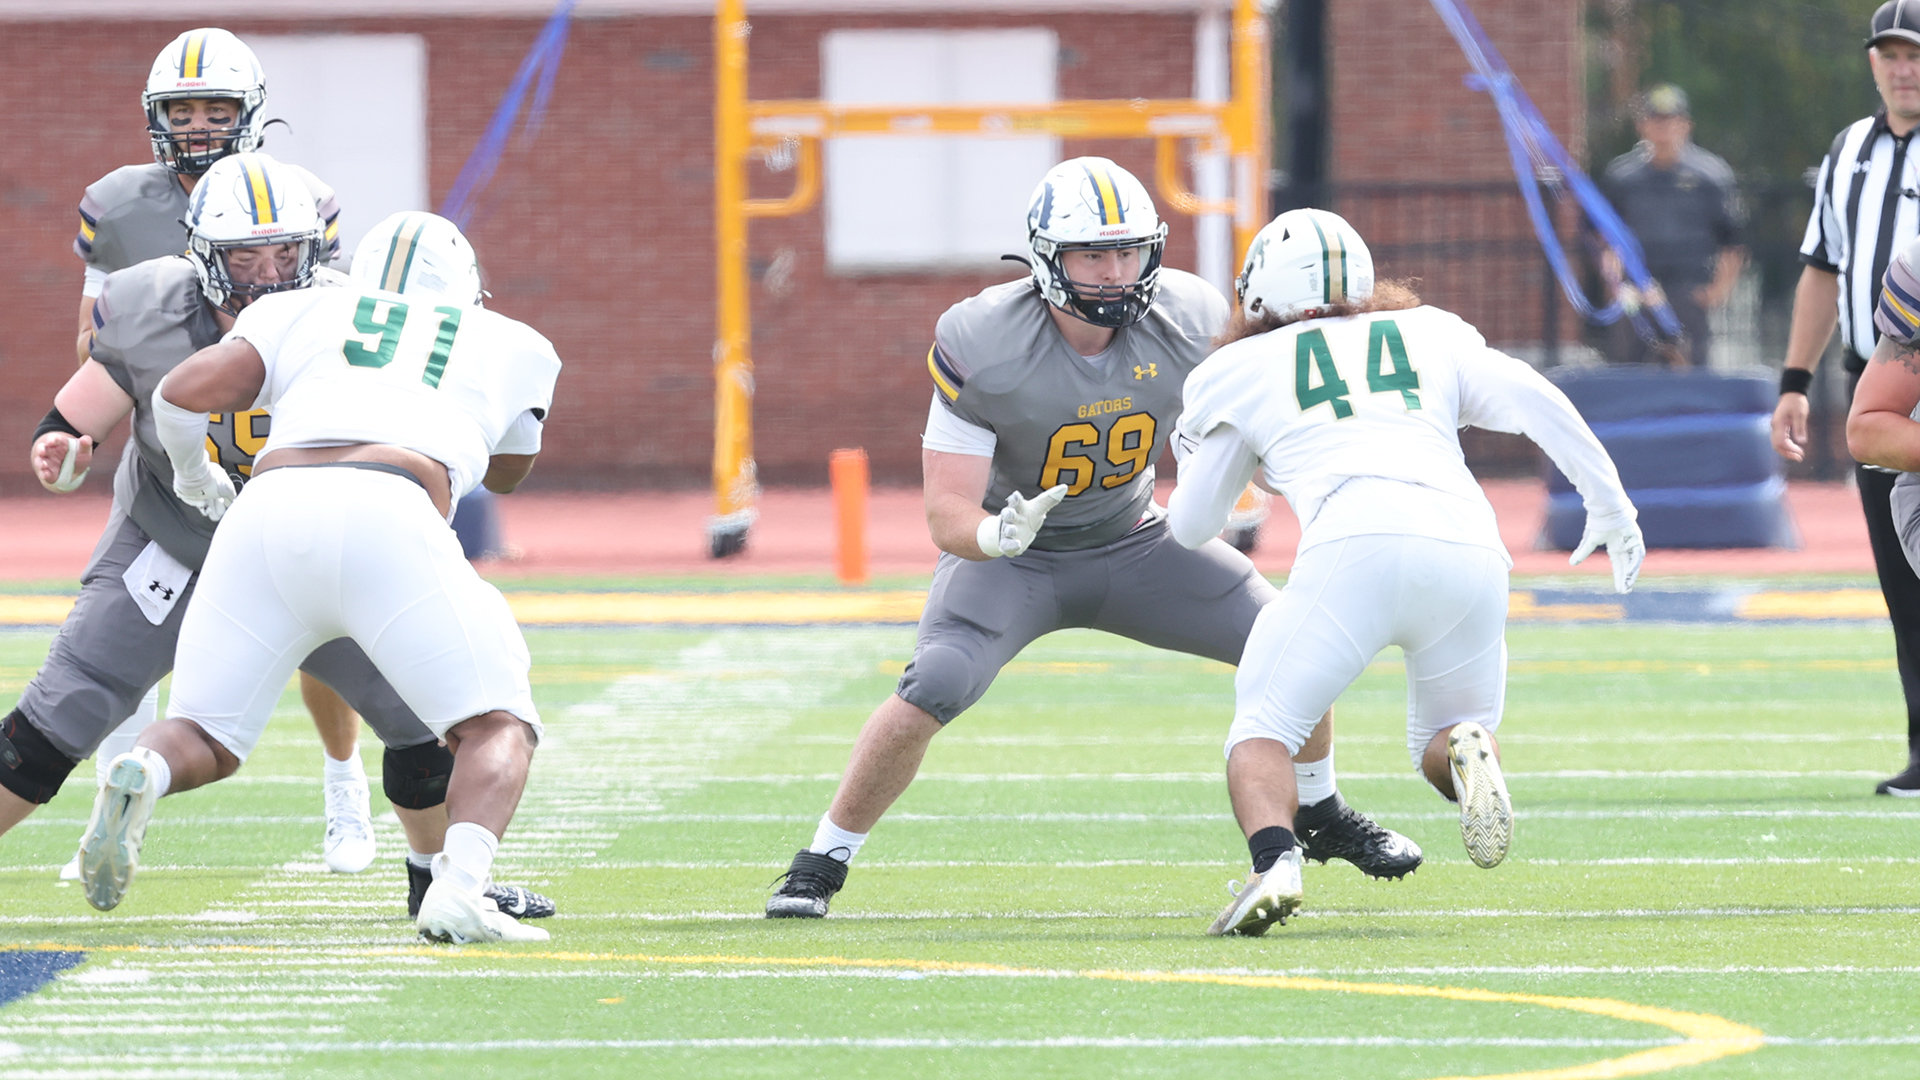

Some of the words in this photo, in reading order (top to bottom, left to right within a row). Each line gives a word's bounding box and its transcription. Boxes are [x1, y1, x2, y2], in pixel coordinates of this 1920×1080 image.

[342, 295, 462, 390] 91
[1294, 319, 1423, 420] 44
[1078, 397, 1132, 418] GATORS
[1037, 411, 1157, 498] 69
